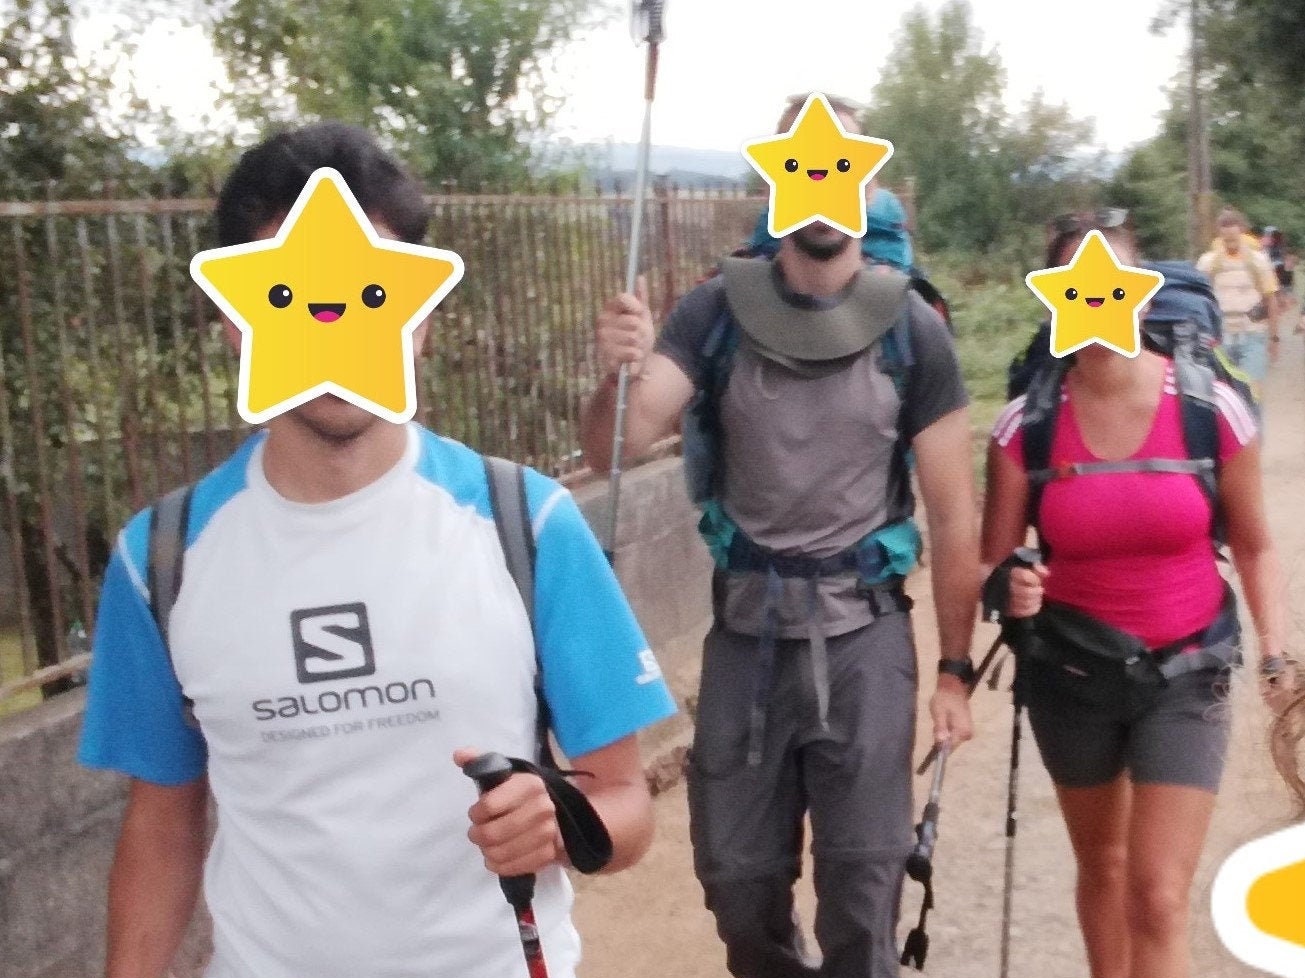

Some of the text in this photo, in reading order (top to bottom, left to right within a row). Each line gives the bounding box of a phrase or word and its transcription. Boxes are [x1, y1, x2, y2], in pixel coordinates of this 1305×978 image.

[296, 608, 370, 677] S
[260, 710, 441, 743] DESIGNED FOR FREEDOM
